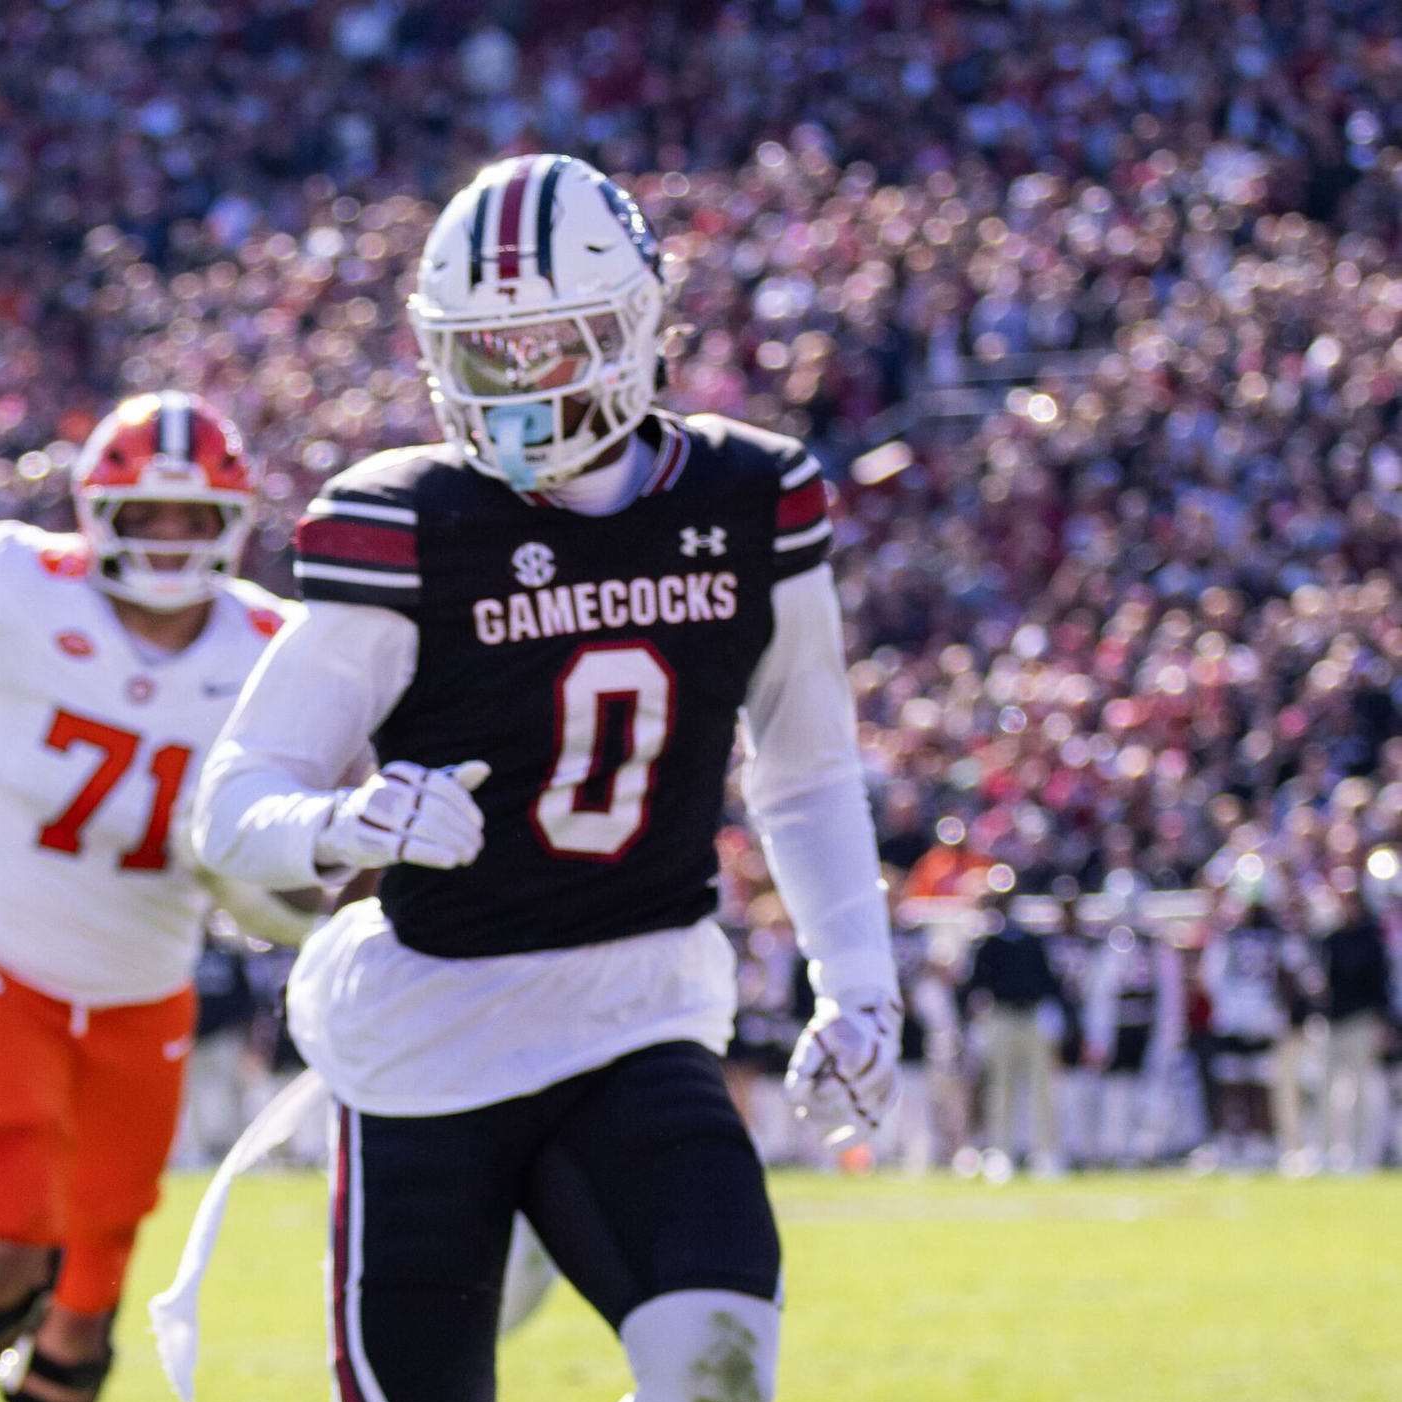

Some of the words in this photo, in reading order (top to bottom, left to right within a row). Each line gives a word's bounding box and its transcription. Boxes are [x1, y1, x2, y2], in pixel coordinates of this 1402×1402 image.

[472, 570, 739, 646] GAMECOCKS
[35, 705, 193, 874] 71
[529, 637, 679, 863] 0
